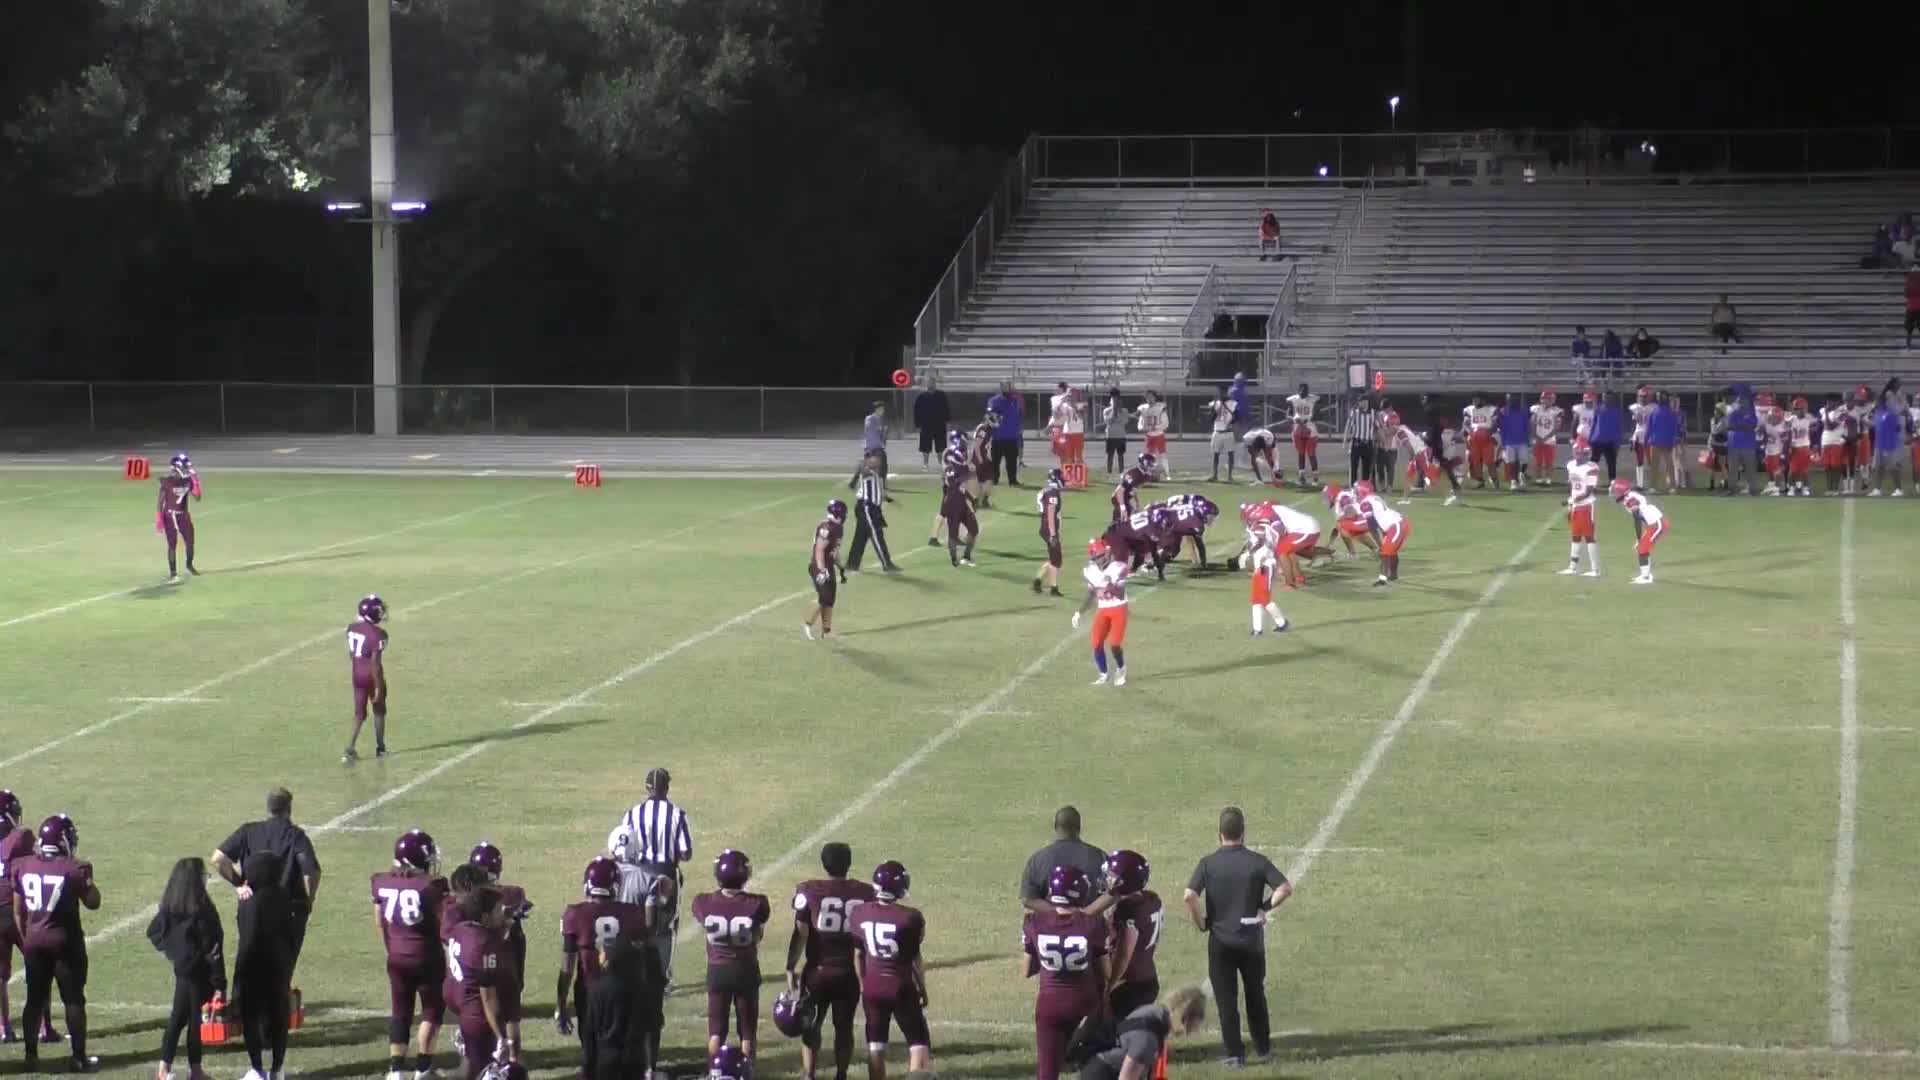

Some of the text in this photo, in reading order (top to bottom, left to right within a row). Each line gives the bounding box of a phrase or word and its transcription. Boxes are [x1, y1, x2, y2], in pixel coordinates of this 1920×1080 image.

[127, 459, 143, 476] 10
[577, 467, 594, 484] 20
[1064, 464, 1083, 482] 30
[348, 631, 366, 657] 17
[22, 873, 64, 912] 97
[378, 888, 423, 926] 78
[860, 921, 899, 958] 15
[1037, 934, 1088, 971] 52
[483, 954, 497, 970] 16
